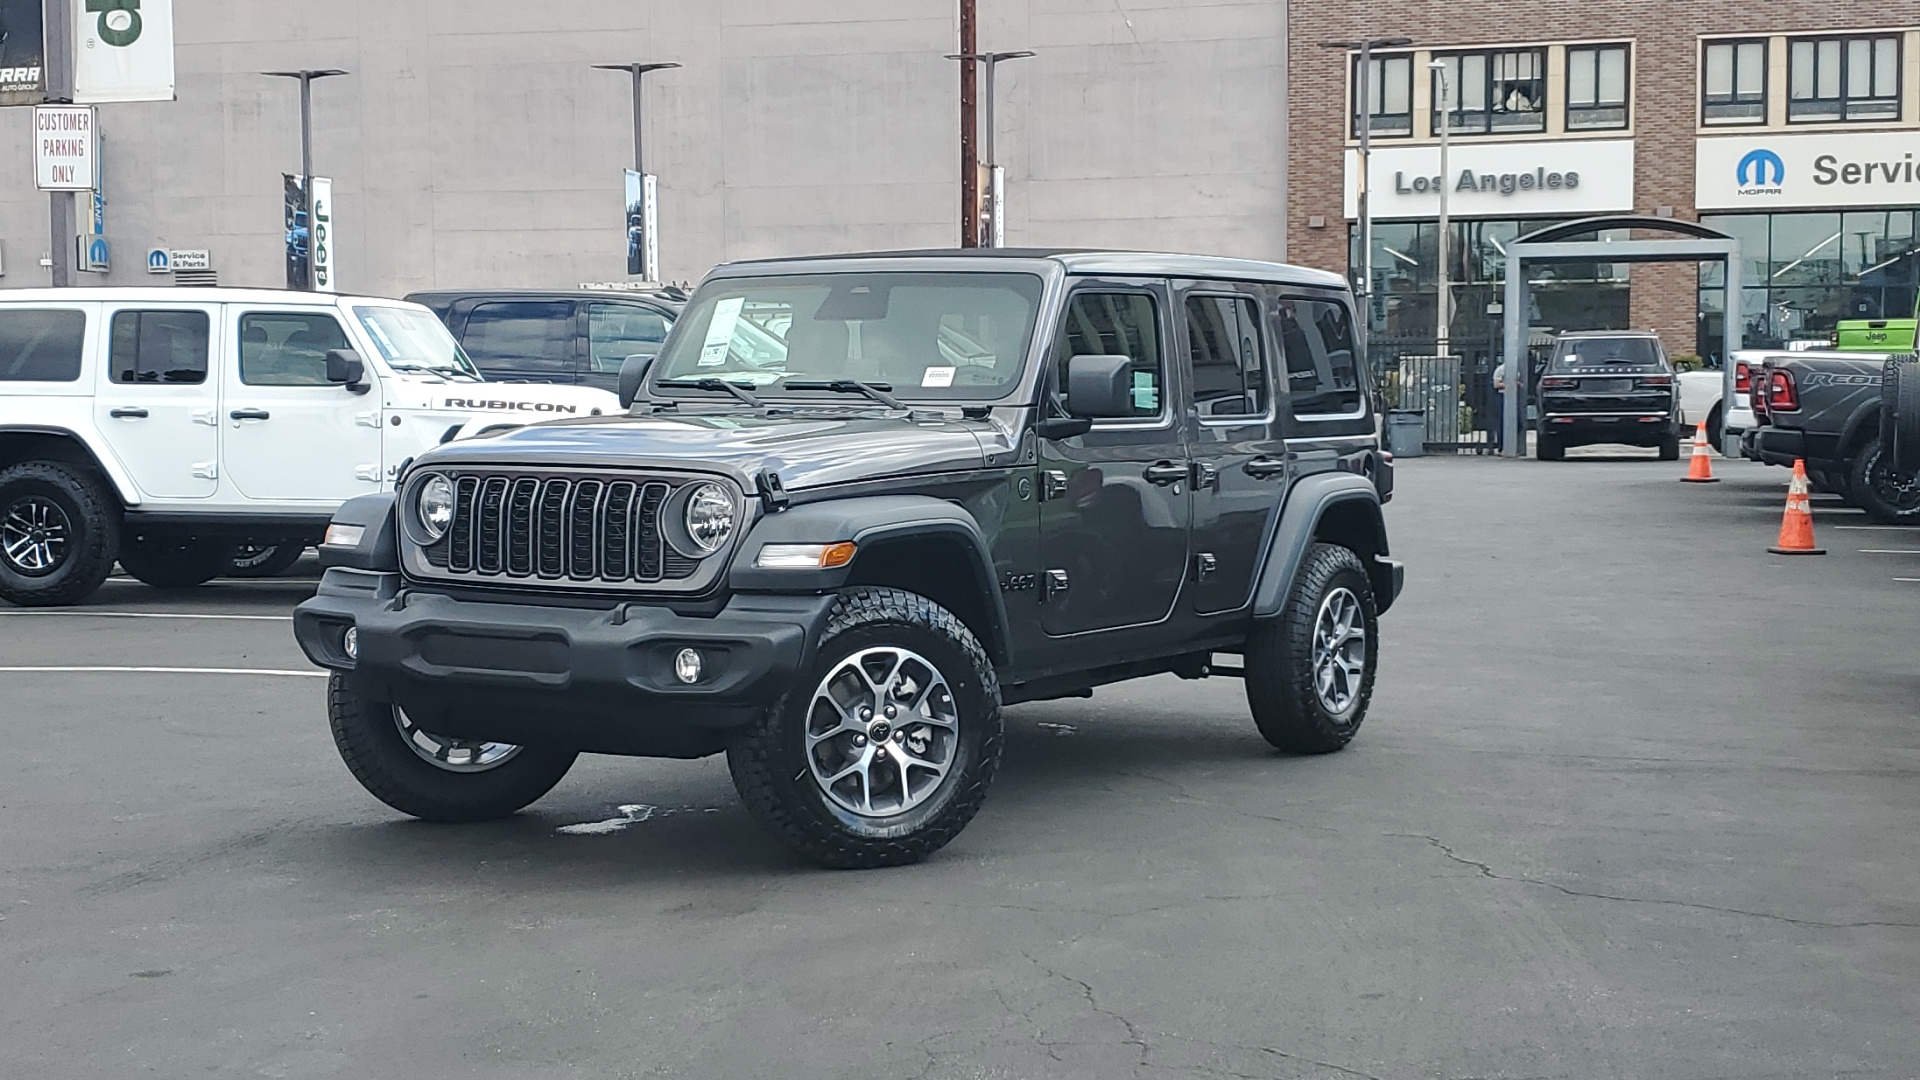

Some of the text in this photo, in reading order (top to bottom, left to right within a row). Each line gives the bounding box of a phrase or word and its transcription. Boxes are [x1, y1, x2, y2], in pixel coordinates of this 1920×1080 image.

[0, 67, 41, 82] RRA
[38, 113, 89, 131] CUSTOMER
[43, 139, 84, 157] PARKING
[52, 165, 75, 183] ONLY
[1813, 153, 1920, 185] Servi
[1395, 166, 1580, 196] Los Angeles
[1737, 188, 1782, 196] MOPAR
[315, 199, 330, 287] Jeep
[1865, 331, 1888, 341] Jeep
[444, 398, 577, 414] RUBICON
